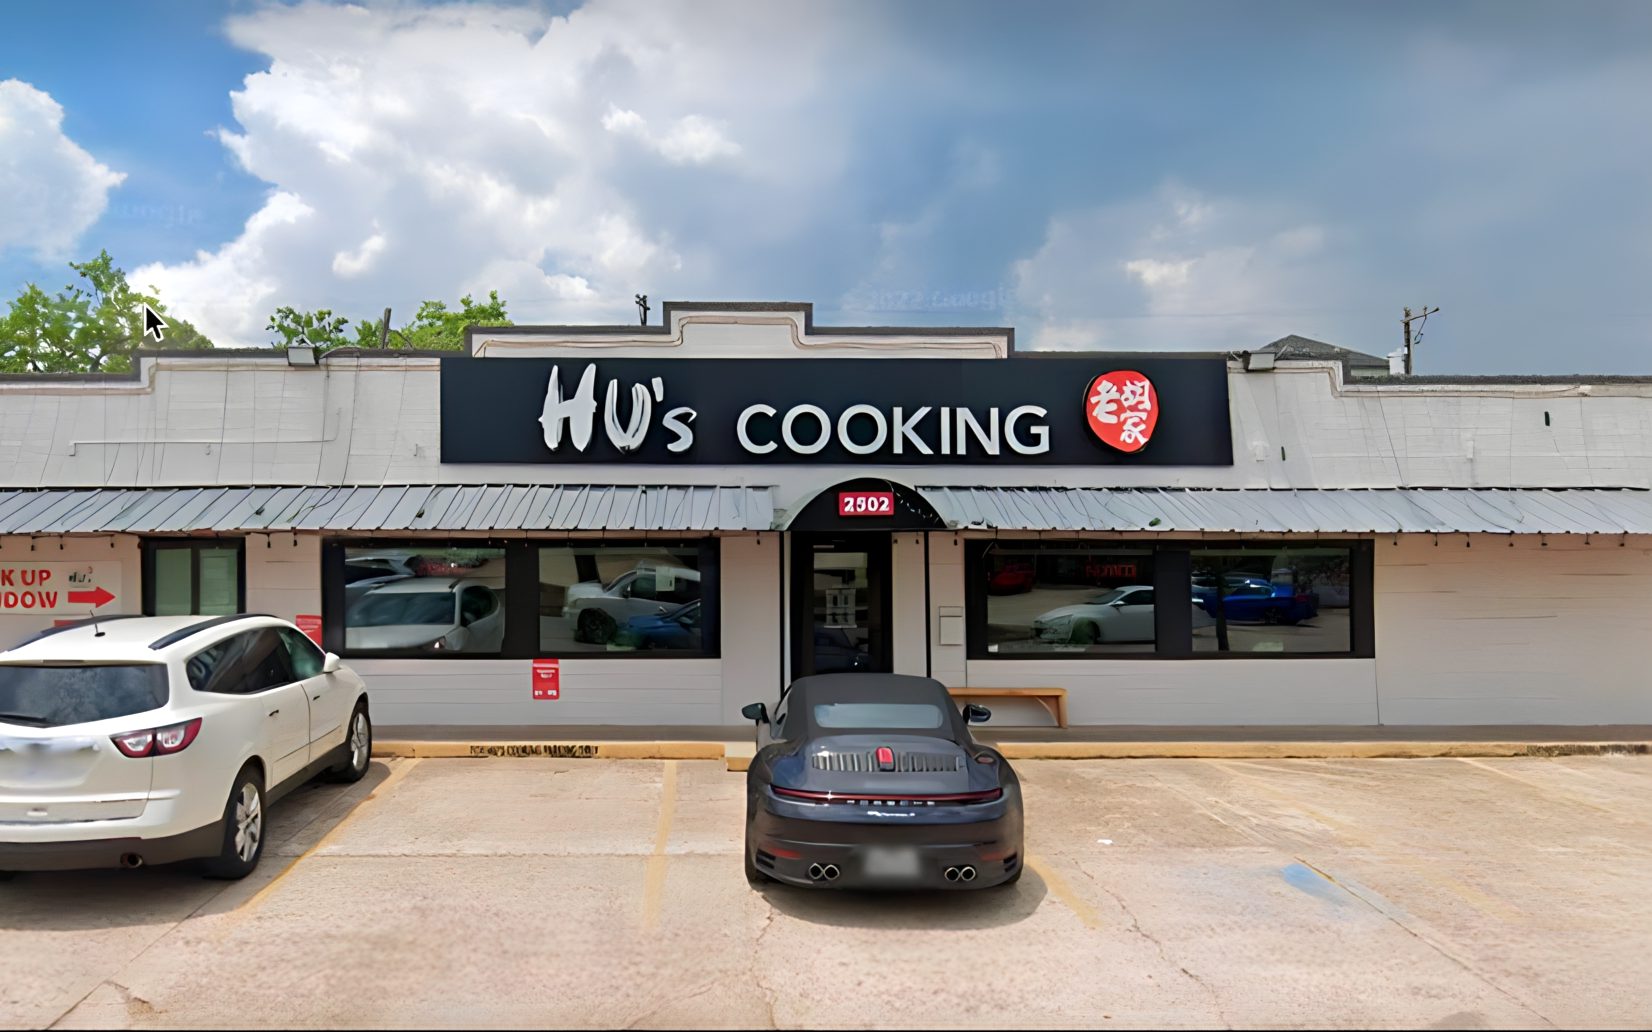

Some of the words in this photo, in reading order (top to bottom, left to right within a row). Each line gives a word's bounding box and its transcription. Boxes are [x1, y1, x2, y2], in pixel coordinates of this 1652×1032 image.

[736, 403, 1050, 455] COOKING
[843, 496, 890, 513] 2502
[20, 569, 52, 587] UP
[0, 590, 58, 609] DOW
